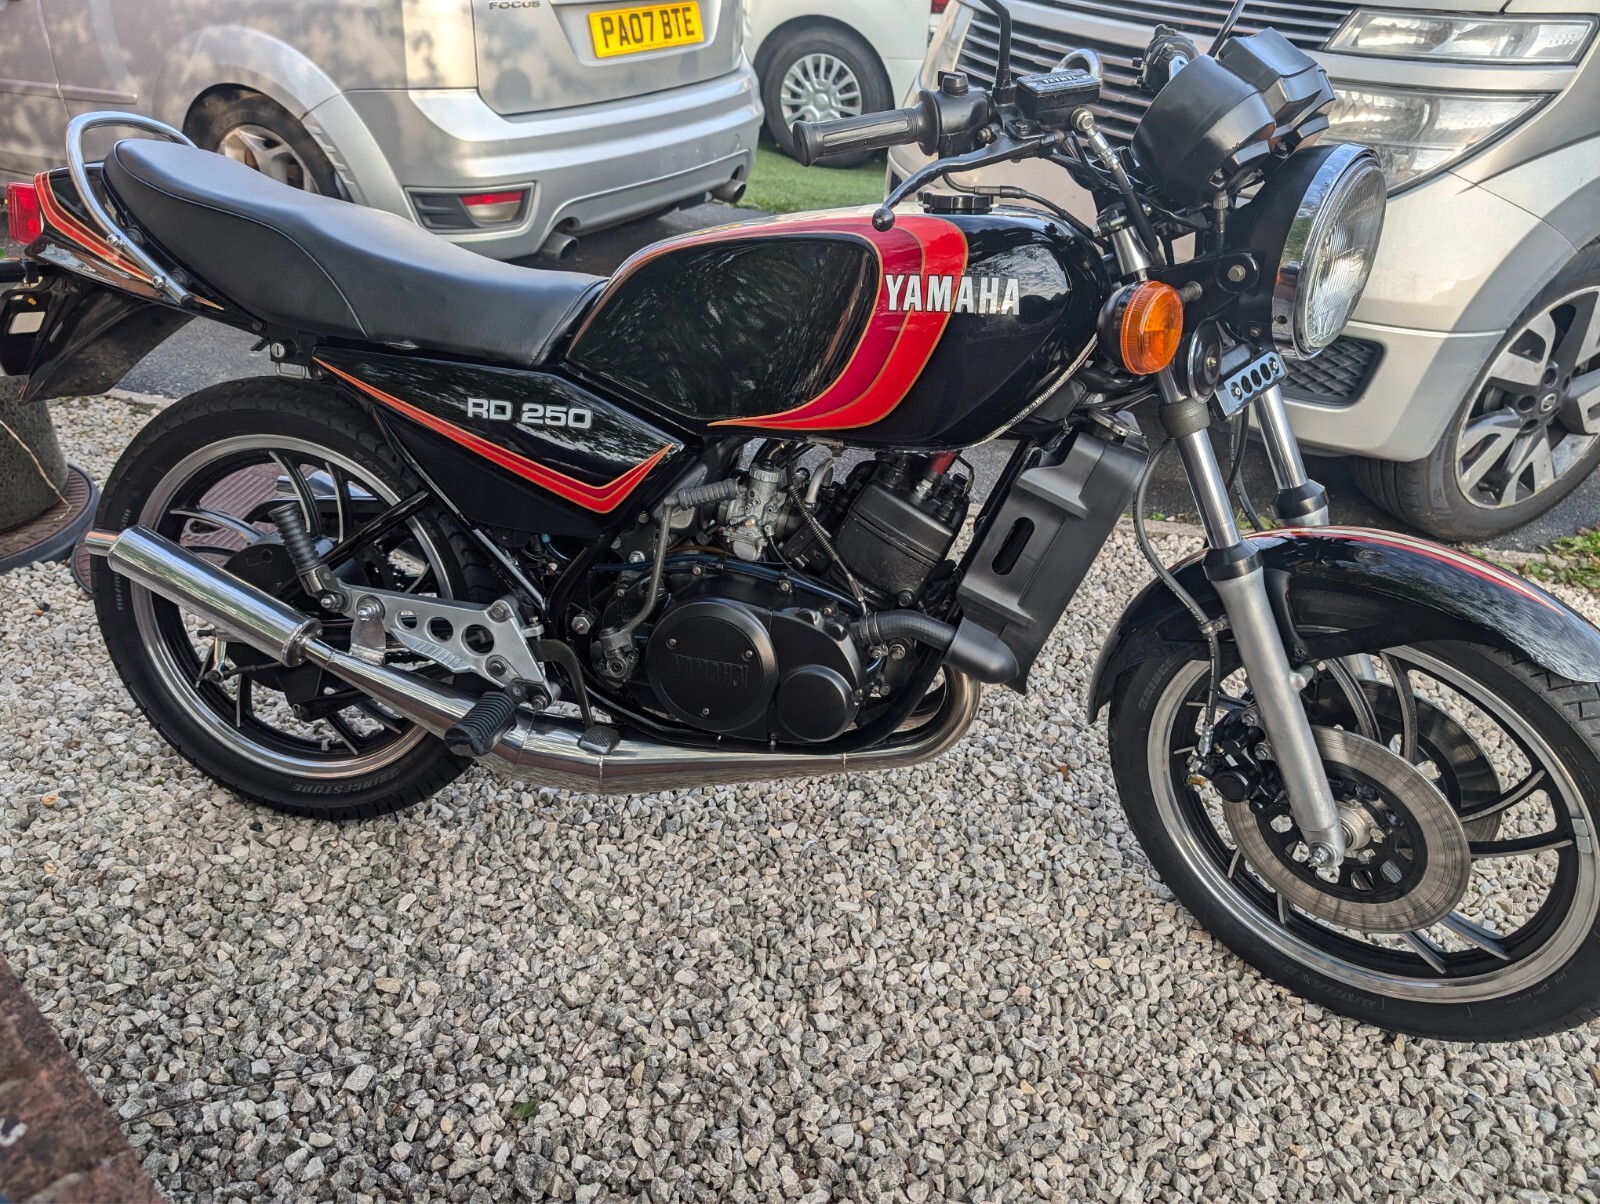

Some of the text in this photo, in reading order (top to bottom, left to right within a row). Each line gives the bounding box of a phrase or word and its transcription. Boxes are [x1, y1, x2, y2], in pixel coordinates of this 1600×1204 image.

[489, 0, 541, 10] FOCUS
[600, 7, 695, 49] PA07 BTE
[885, 274, 1020, 316] YAMAHA
[467, 397, 592, 429] RD 250
